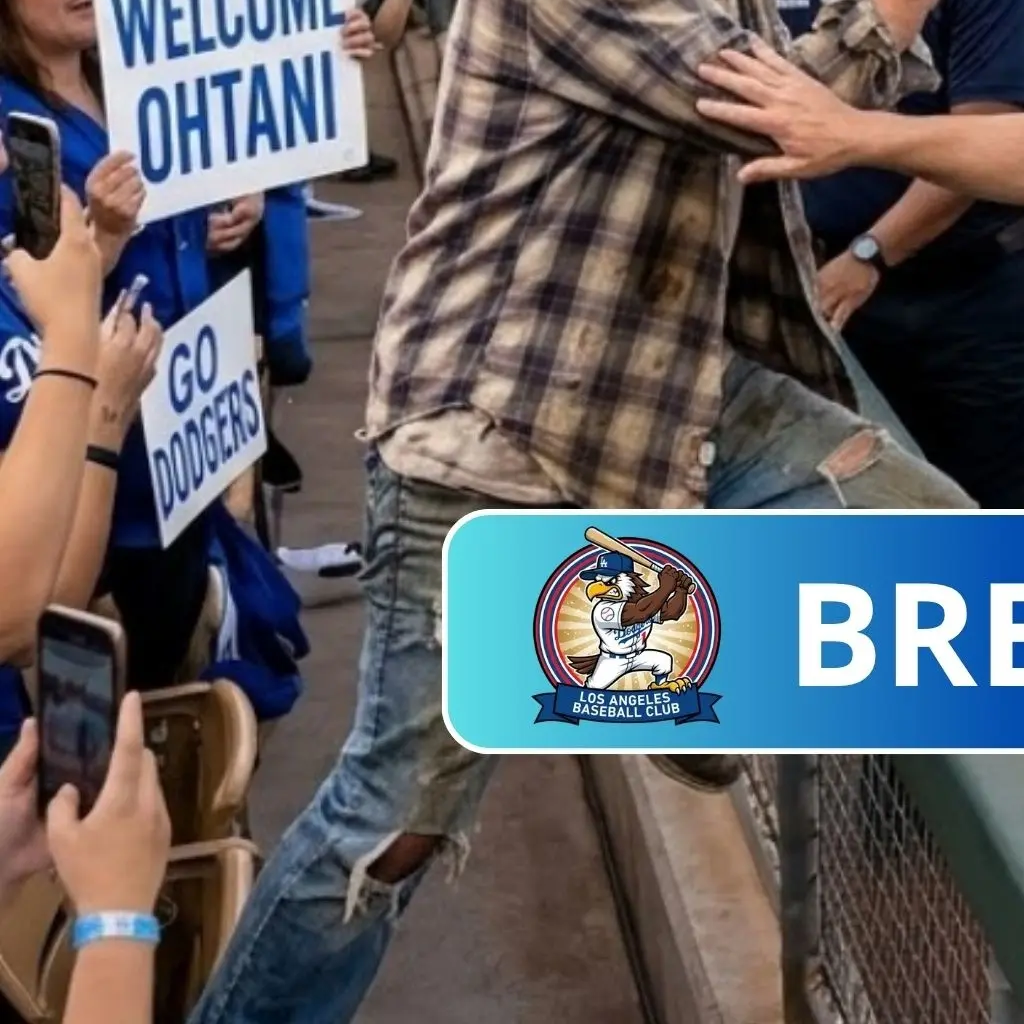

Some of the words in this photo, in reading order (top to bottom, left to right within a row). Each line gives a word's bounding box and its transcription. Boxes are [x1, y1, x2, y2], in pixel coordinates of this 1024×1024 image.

[137, 50, 337, 184] OHTANI
[168, 324, 218, 414] GO
[152, 369, 260, 521] DODGERS
